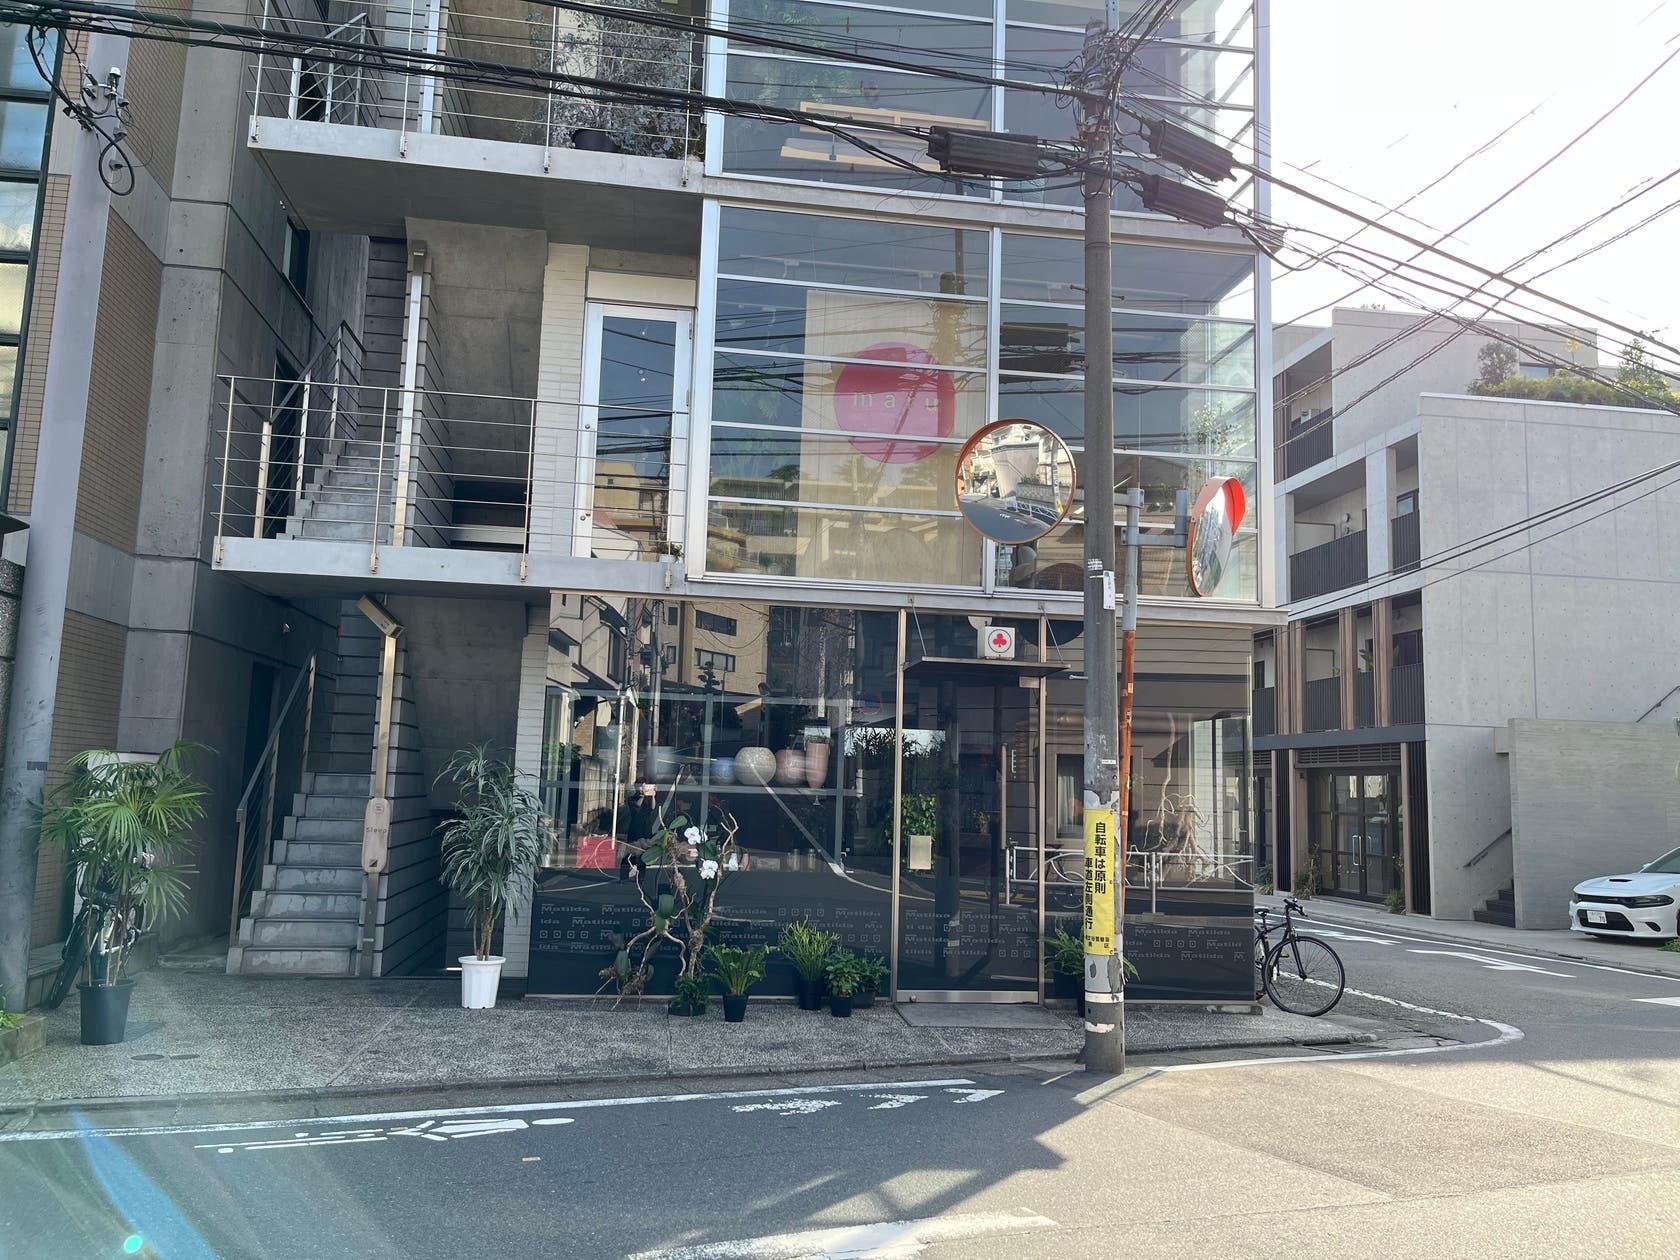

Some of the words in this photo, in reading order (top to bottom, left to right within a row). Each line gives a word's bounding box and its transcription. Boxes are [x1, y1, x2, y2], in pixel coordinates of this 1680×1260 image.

[1084, 857, 1094, 930] 車道左側通行
[1094, 822, 1107, 895] 自転車は原則
[541, 904, 590, 914] Matilda
